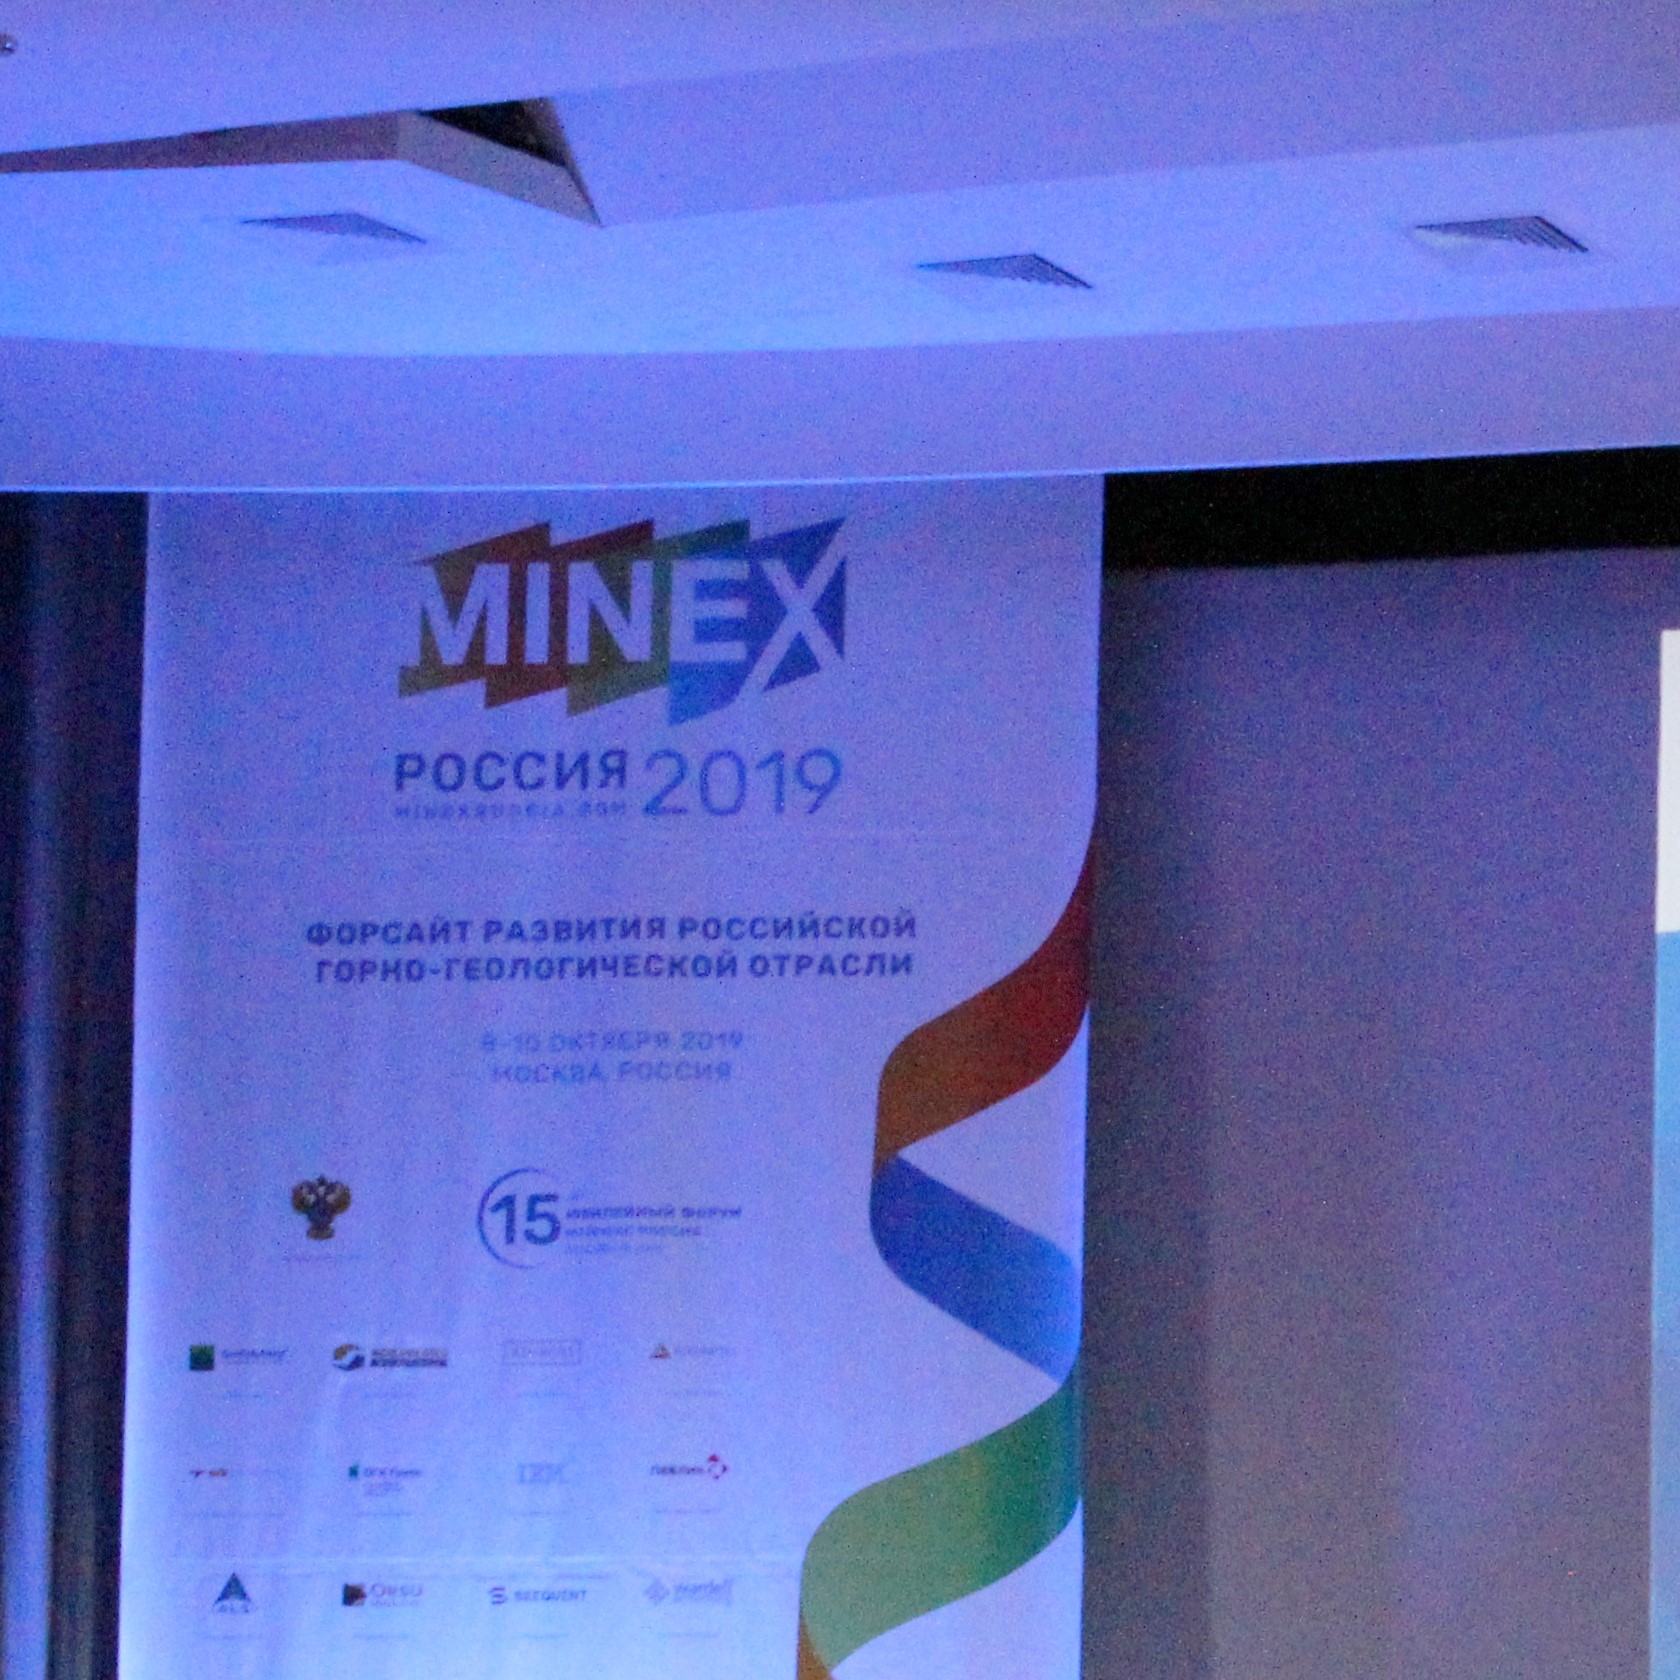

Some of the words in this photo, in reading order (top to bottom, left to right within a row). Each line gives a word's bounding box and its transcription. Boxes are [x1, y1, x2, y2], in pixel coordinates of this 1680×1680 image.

[401, 517, 847, 726] MINEX
[394, 749, 629, 794] РОССИЯ
[641, 746, 845, 817] 2019
[306, 915, 471, 947] ФОРСАЙТ
[483, 915, 665, 943] РАЗВИТИЯ
[678, 908, 916, 941] РОССИЙСКОЙ
[315, 948, 738, 986] ГОРНО-ГЕОЛОГИЧЕСКОЙ
[750, 950, 914, 978] ОТРАСЛИ
[550, 1031, 672, 1053] ОКТЯБРЯ
[681, 1029, 744, 1051] 2019
[619, 1060, 732, 1083] РОССИЯ
[489, 1192, 562, 1246] 15
